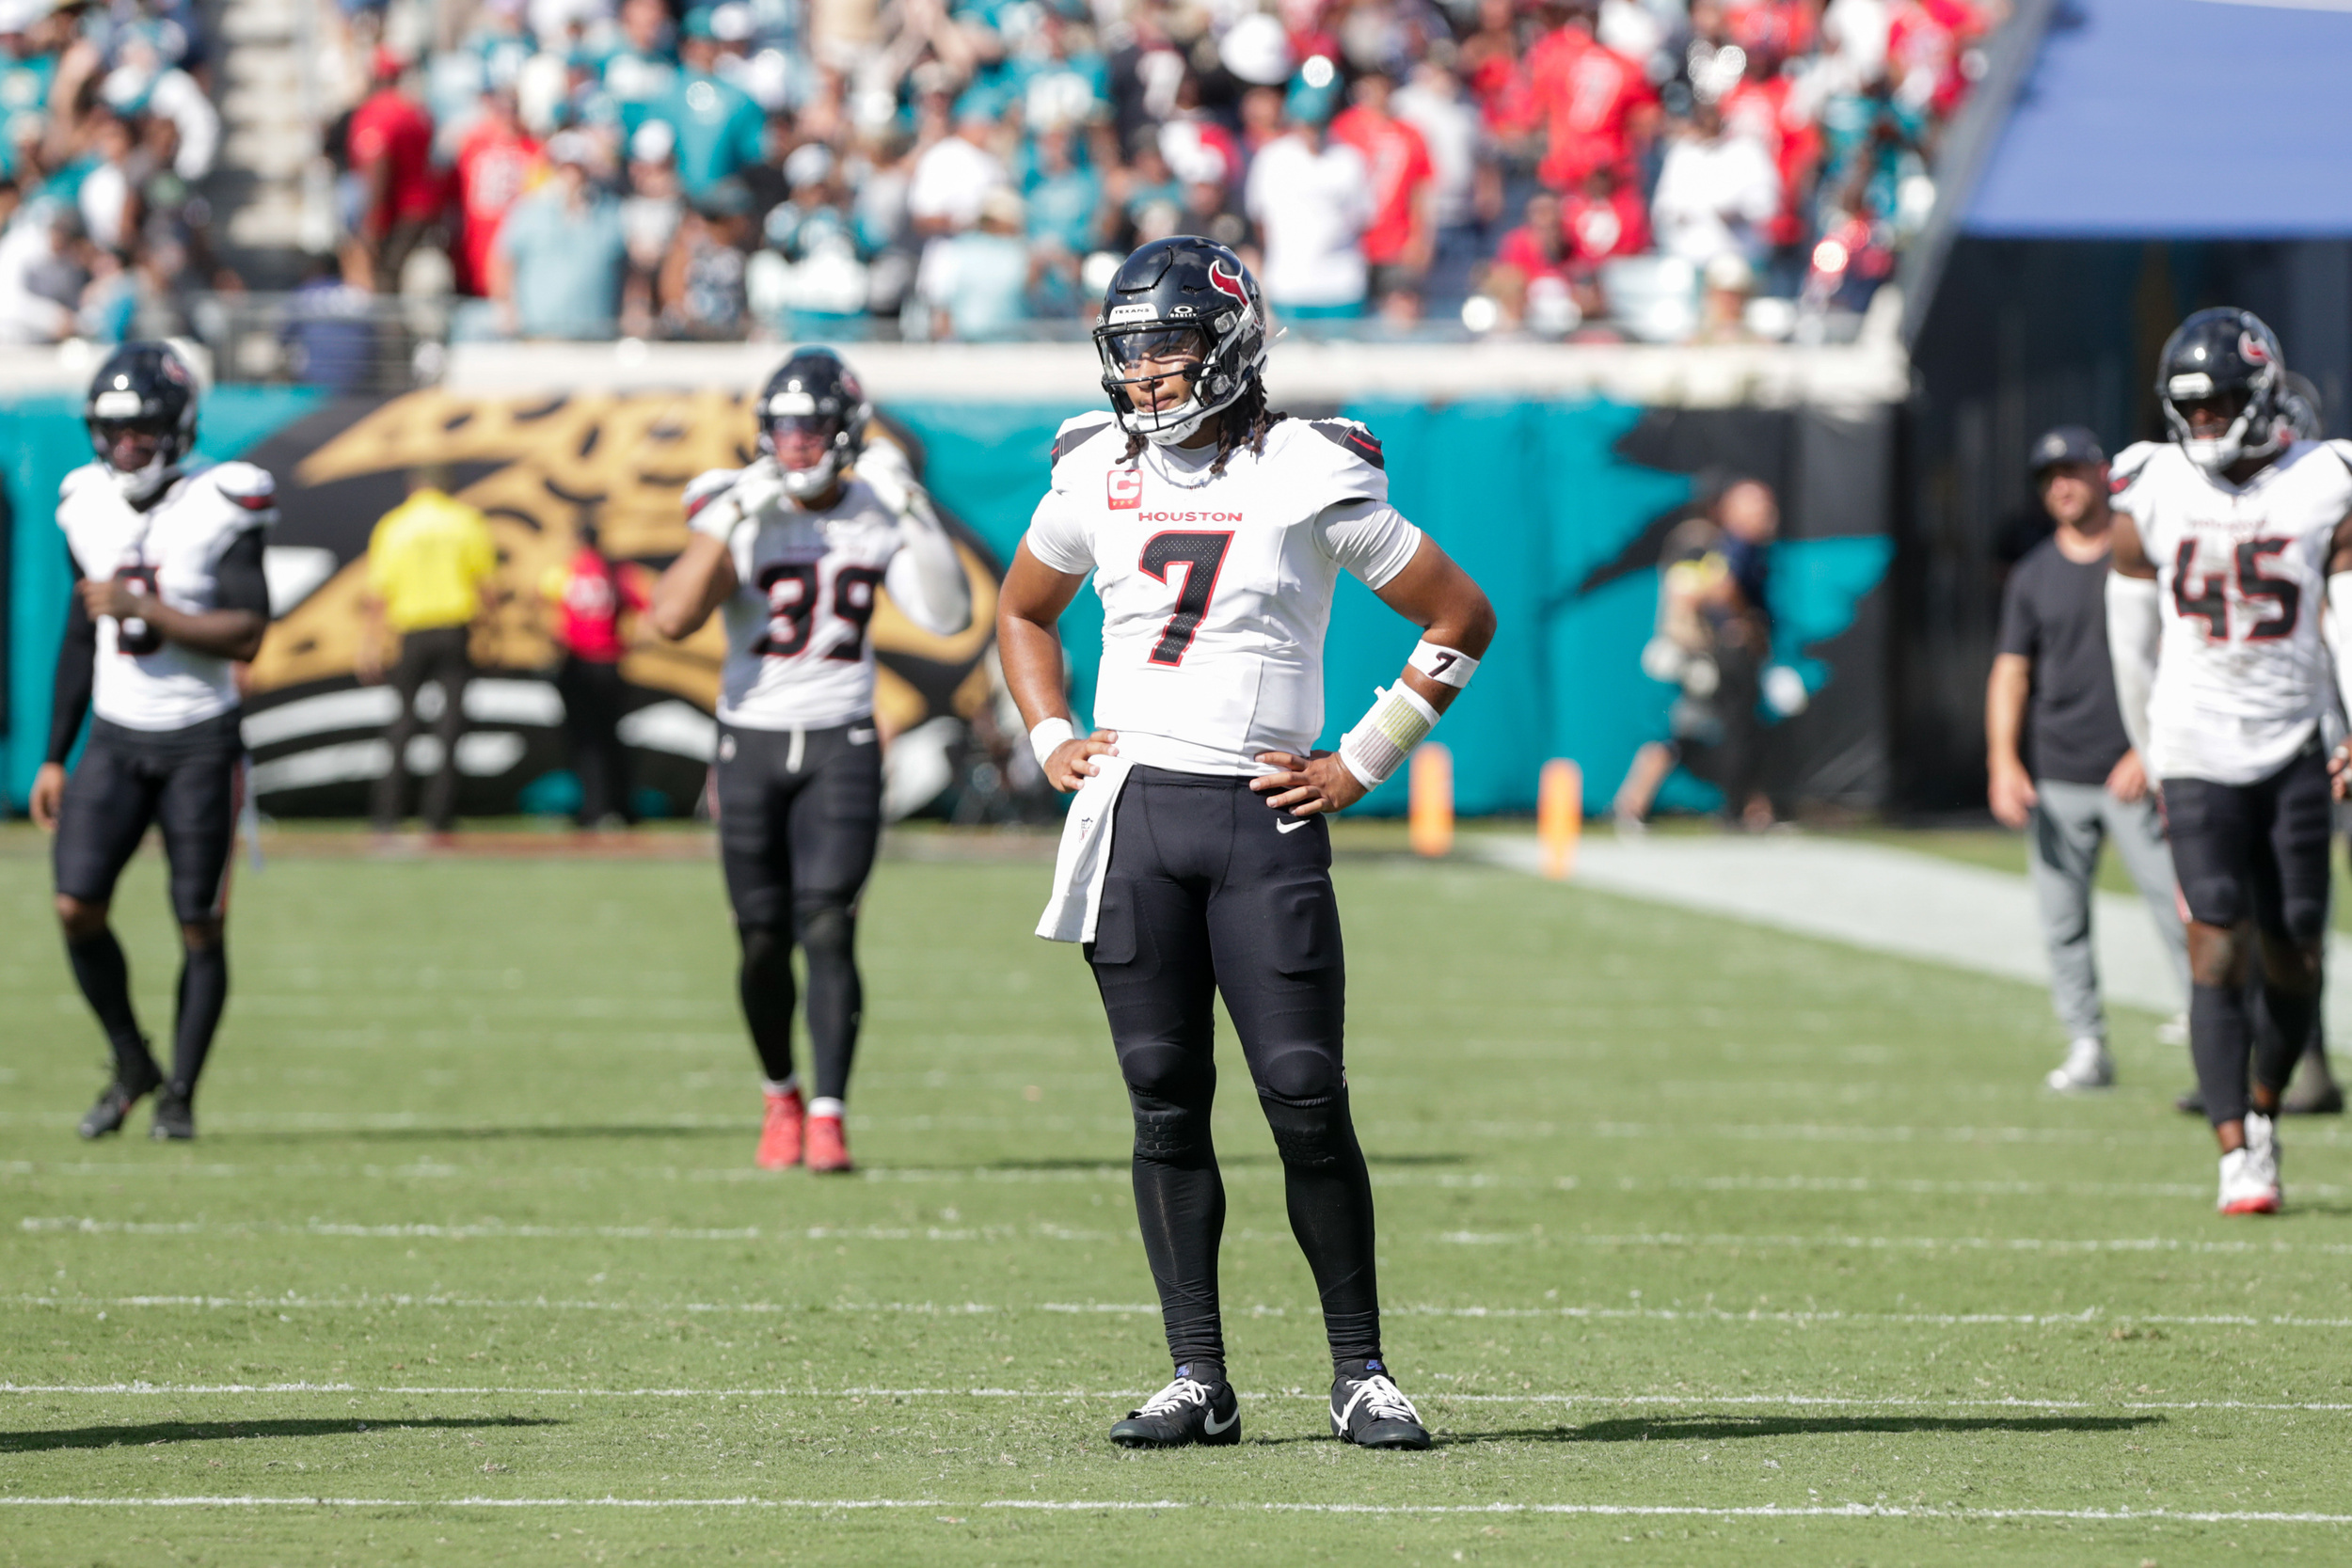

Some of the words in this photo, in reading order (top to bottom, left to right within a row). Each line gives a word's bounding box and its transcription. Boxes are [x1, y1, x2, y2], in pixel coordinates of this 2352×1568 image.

[1108, 469, 1140, 499] C
[1138, 511, 1243, 522] HOUSTON
[751, 562, 886, 662] 39
[1138, 530, 1236, 668] 7
[2172, 536, 2301, 642] 45
[1427, 651, 1458, 679] 7
